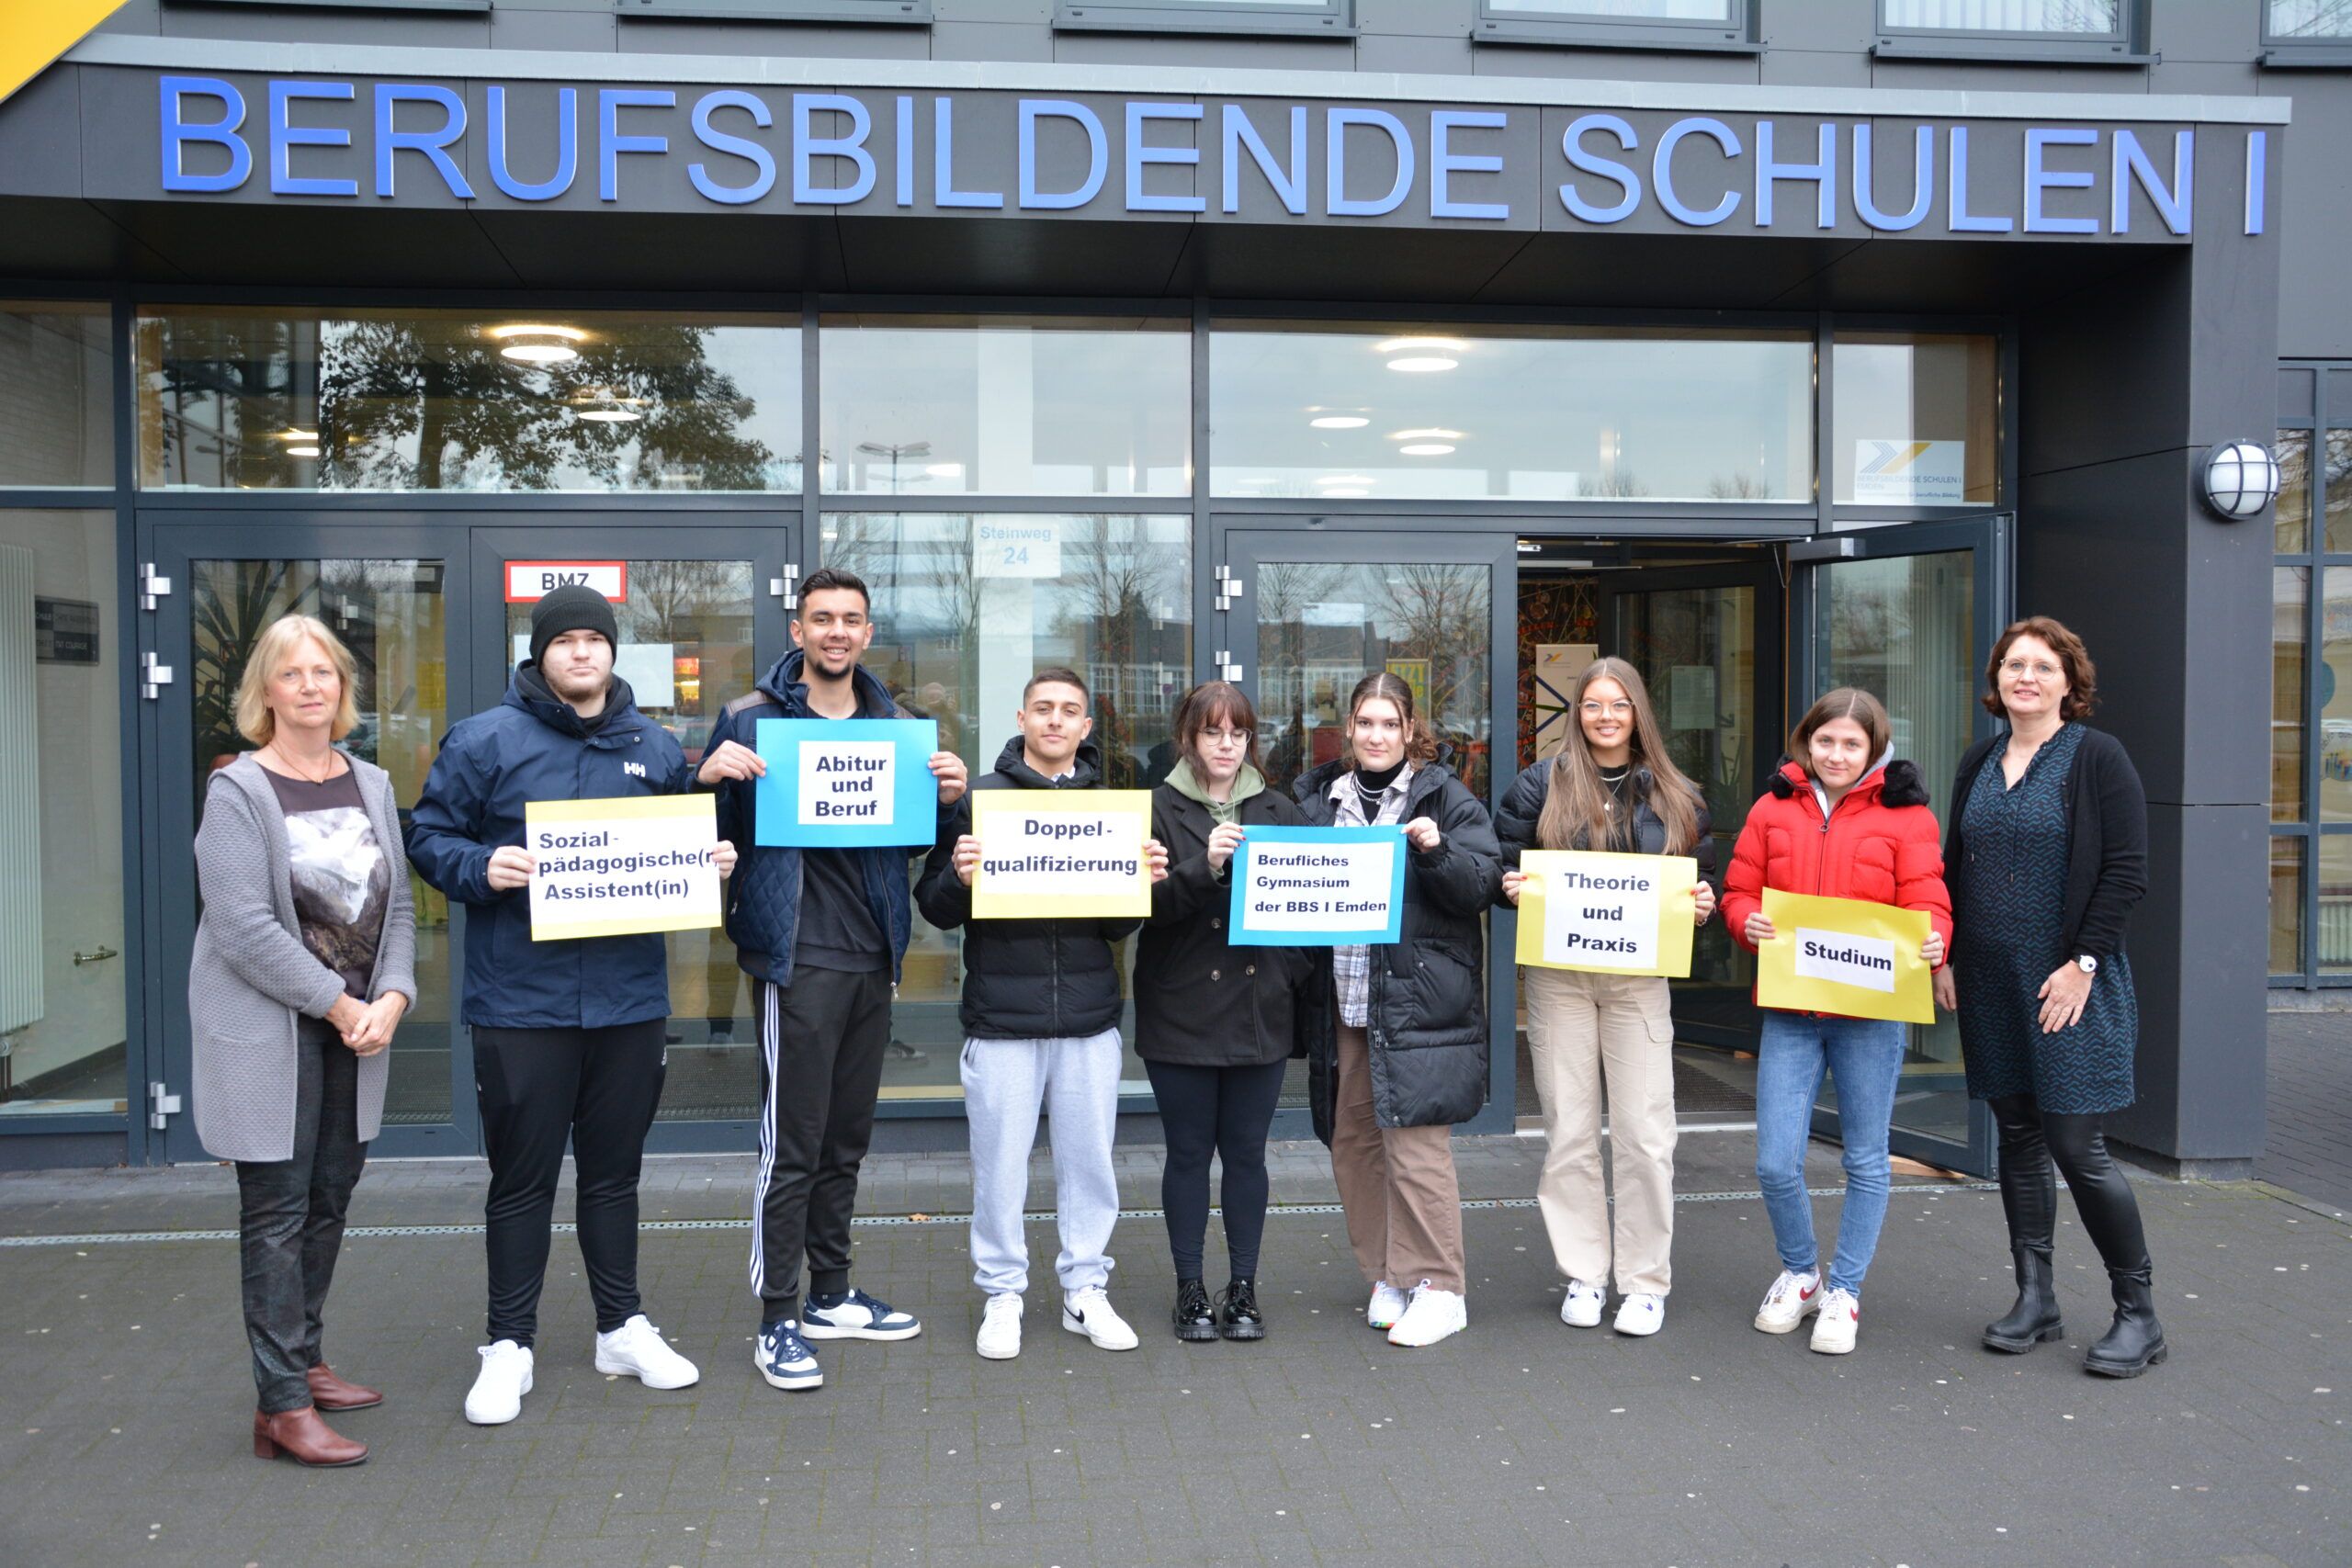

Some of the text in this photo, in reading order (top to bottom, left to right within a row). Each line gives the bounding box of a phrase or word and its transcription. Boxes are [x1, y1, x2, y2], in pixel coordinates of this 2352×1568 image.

[160, 75, 2266, 236] BERUFSBILDENDE SCHULEN I
[1923, 475, 1958, 484] SCHULEN
[979, 525, 1052, 542] Steinweg
[1003, 546, 1030, 565] 24
[815, 755, 888, 773] Abitur
[831, 775, 874, 793] und
[815, 799, 878, 817] Beruf
[538, 848, 720, 878] pädagogische(r
[982, 855, 1138, 876] qualifizierung
[1257, 854, 1350, 867] Berufliches
[544, 878, 690, 900] Assistent(in)
[1256, 875, 1351, 891] Gymnasium
[1564, 872, 1651, 892] Theorie
[1254, 900, 1387, 913] der BBS I Emden
[1582, 905, 1623, 921] und
[1566, 932, 1638, 953] Praxis
[1804, 941, 1893, 971] Studium
